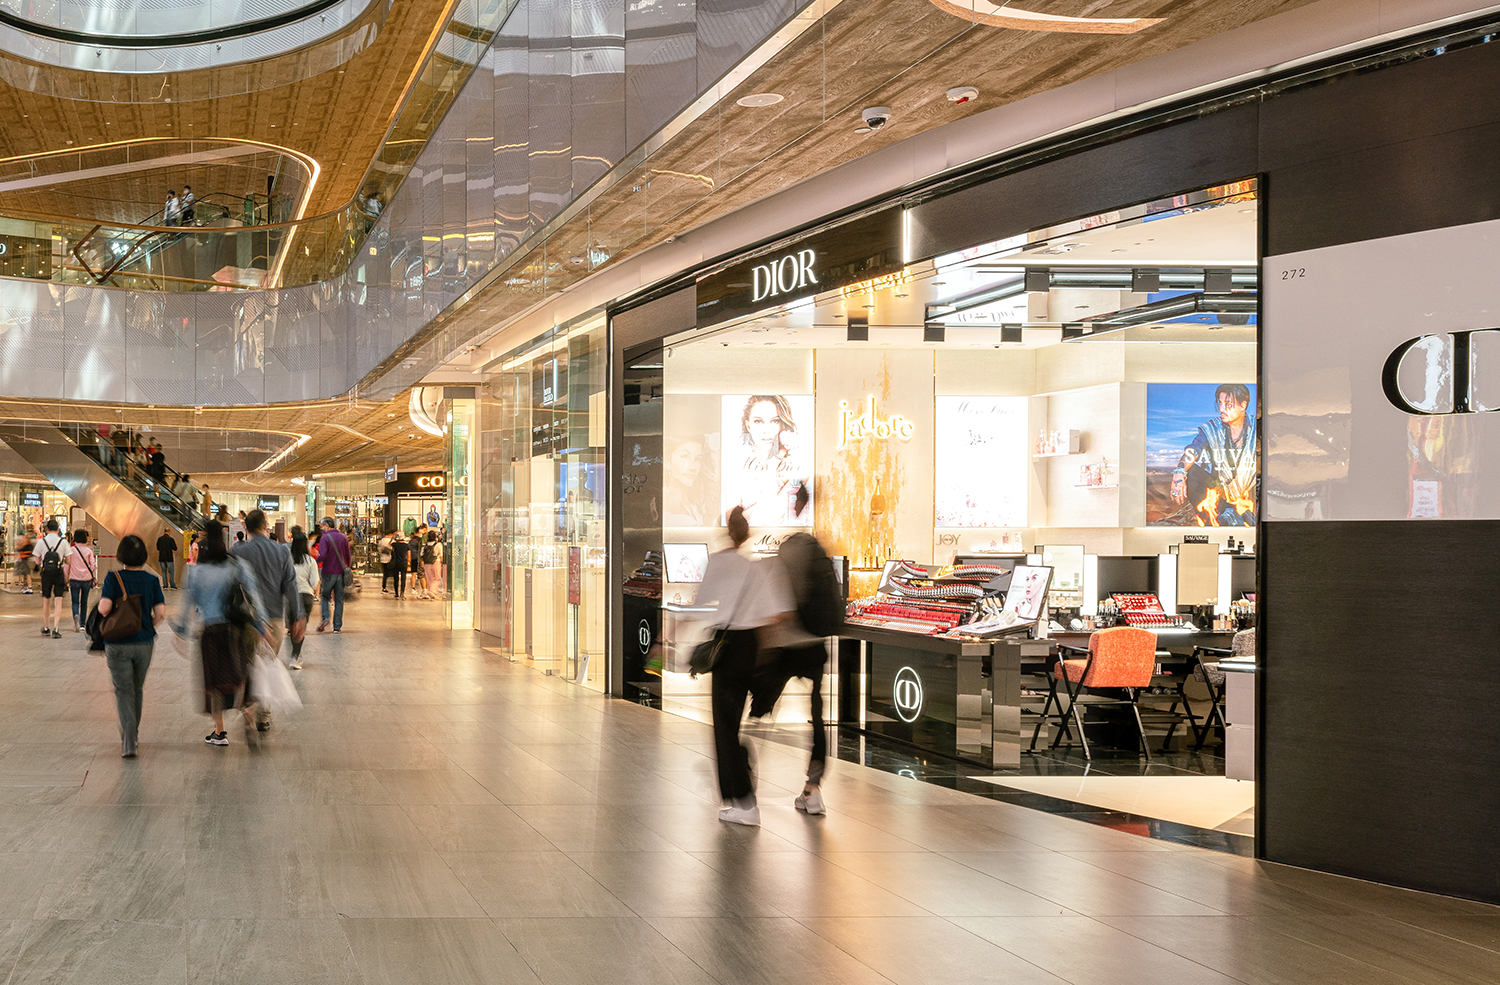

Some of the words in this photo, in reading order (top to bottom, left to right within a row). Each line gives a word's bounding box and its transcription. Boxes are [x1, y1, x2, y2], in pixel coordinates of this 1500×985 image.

[752, 248, 819, 303] DIOR
[1282, 268, 1306, 281] 272
[753, 534, 781, 546] Miss
[935, 533, 962, 546] JOY
